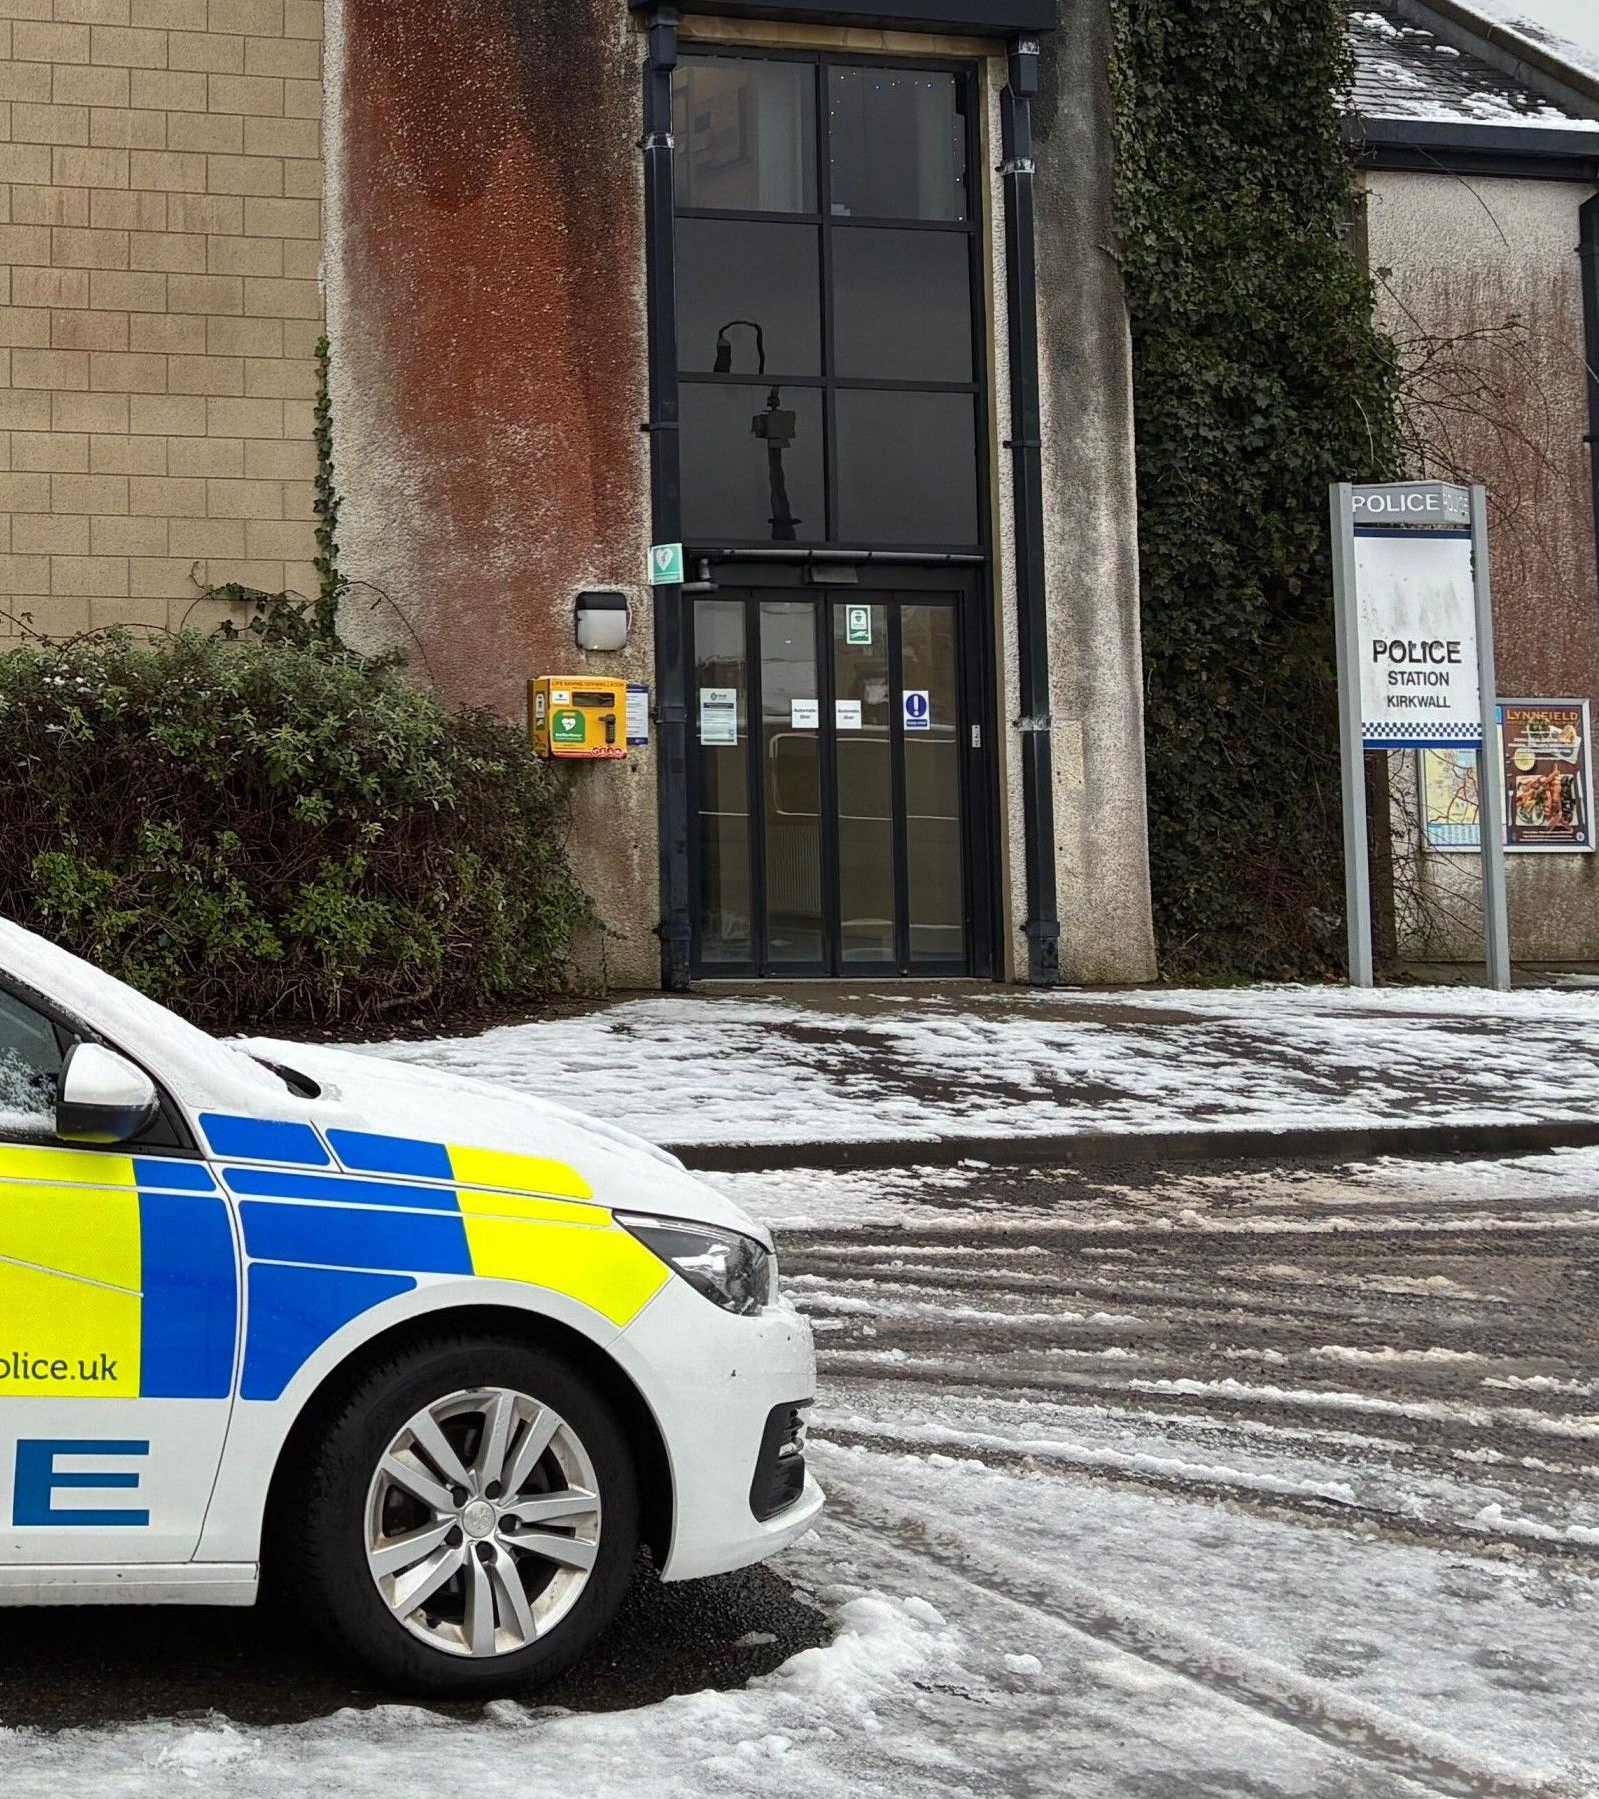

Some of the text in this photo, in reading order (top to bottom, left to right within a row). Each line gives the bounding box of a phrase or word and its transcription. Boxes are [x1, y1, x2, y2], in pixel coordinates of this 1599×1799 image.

[1352, 493, 1440, 513] POLICE
[1372, 639, 1462, 664] POLICE
[1387, 670, 1450, 686] STATION
[1387, 695, 1451, 708] KIRKWALL
[1506, 709, 1579, 721] LYNNFIELD
